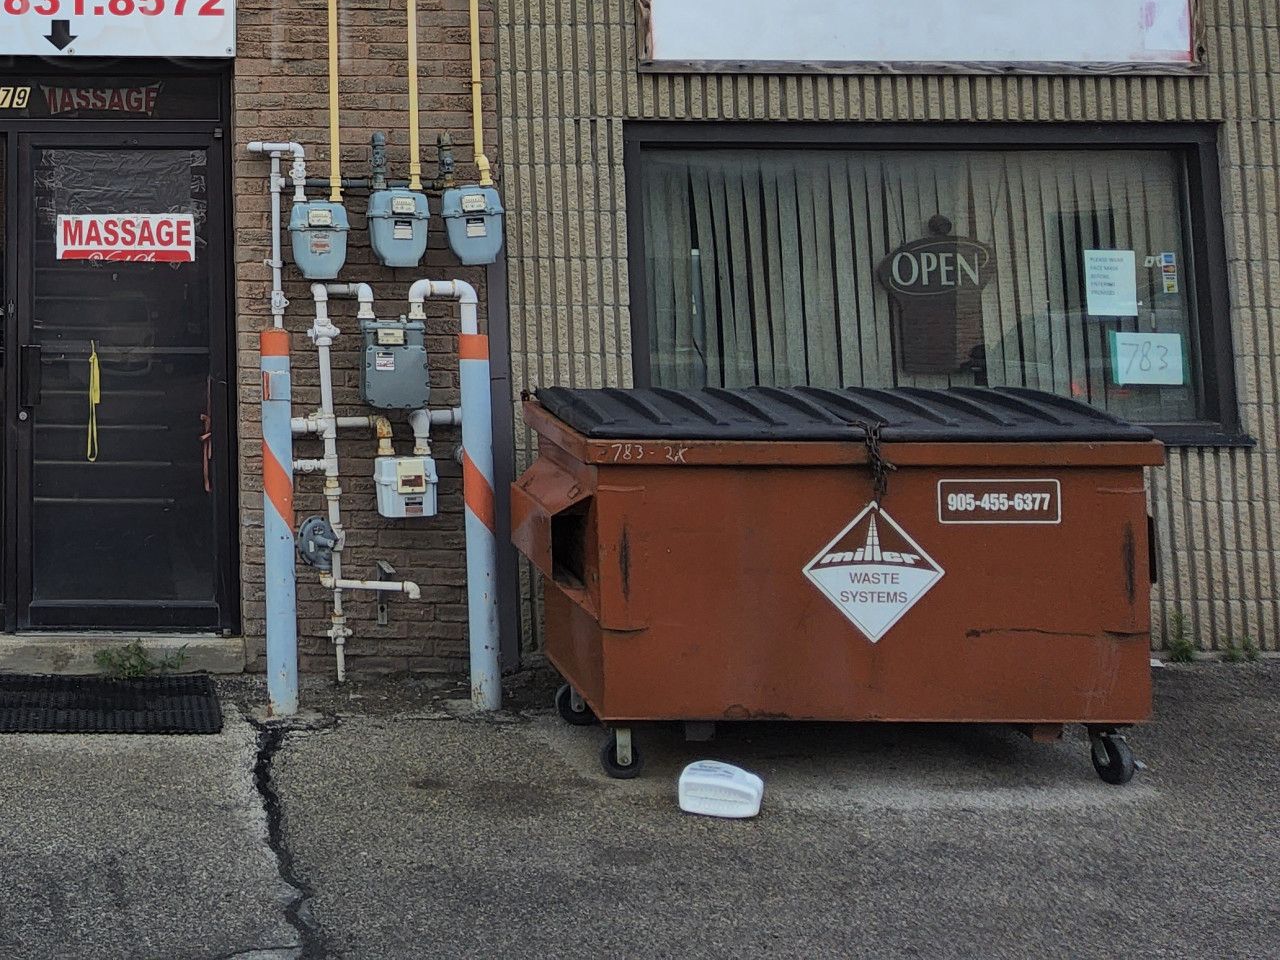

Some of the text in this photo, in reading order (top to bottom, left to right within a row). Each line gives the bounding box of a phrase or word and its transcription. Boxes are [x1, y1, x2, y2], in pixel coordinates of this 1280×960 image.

[63, 219, 192, 247] MASSAGE
[891, 252, 981, 286] OPEN
[1121, 341, 1168, 375] 783
[948, 493, 1050, 511] 905-455-6377
[849, 572, 900, 584] WASTE
[840, 591, 908, 603] SYSTEMS
